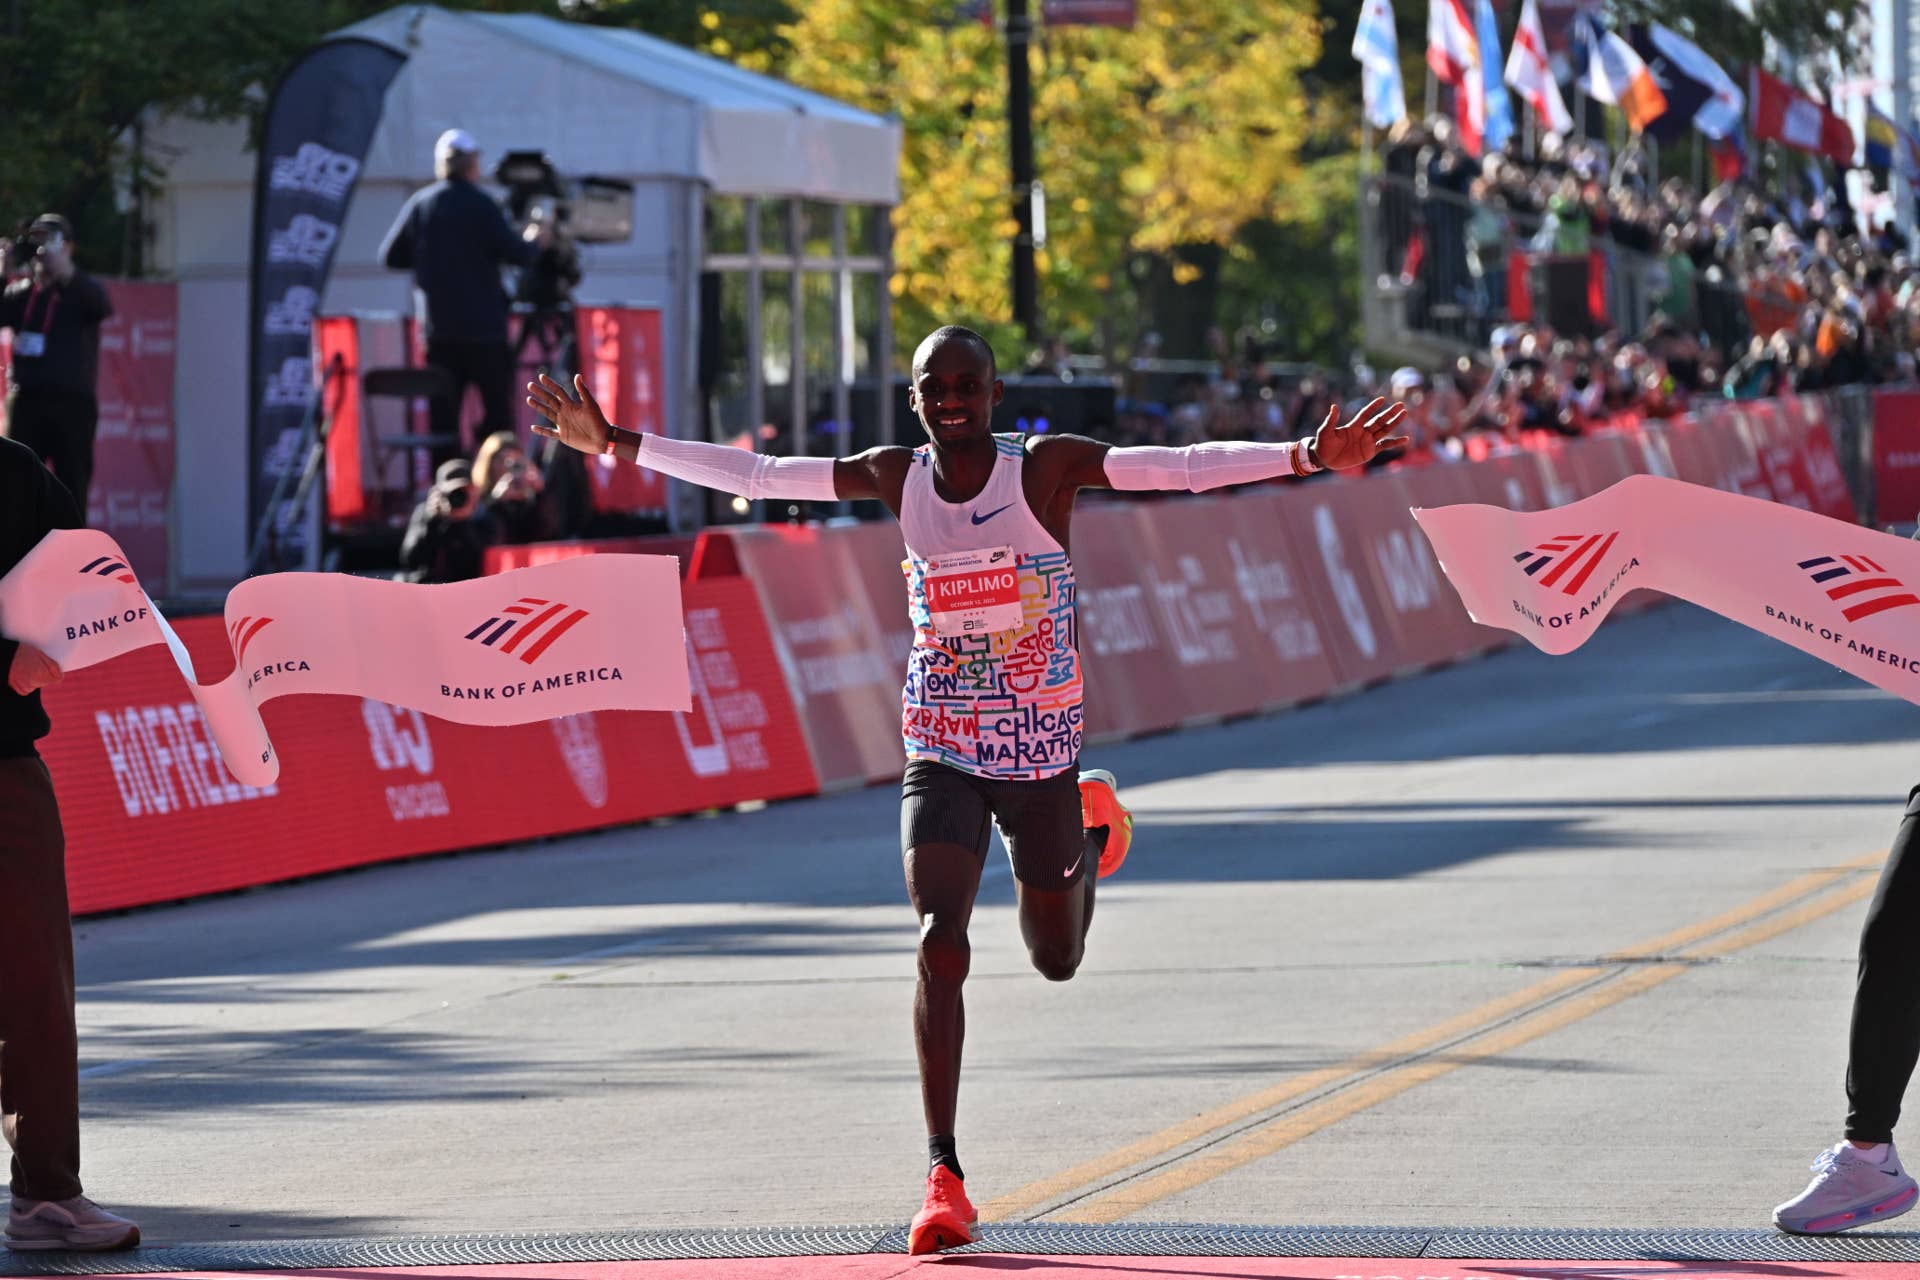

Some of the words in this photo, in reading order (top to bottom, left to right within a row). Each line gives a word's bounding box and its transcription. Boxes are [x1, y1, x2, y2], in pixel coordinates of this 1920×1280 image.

[928, 583, 935, 602] J
[940, 573, 1014, 597] KIPLIMO
[950, 600, 974, 608] OCTOBER
[1513, 600, 1544, 627] BANK
[1548, 612, 1573, 628] OF
[1580, 558, 1640, 619] AMERICA
[66, 615, 119, 640] BANK
[123, 608, 147, 622] OF
[1765, 605, 1815, 633] BANK
[1820, 628, 1842, 643] OF
[1848, 640, 1920, 674] AMERIC
[441, 684, 495, 699] BANK
[502, 682, 526, 697] OF
[532, 667, 623, 692] AMERICA
[995, 702, 1083, 737] CHICAG
[95, 702, 280, 818] BIOFREE
